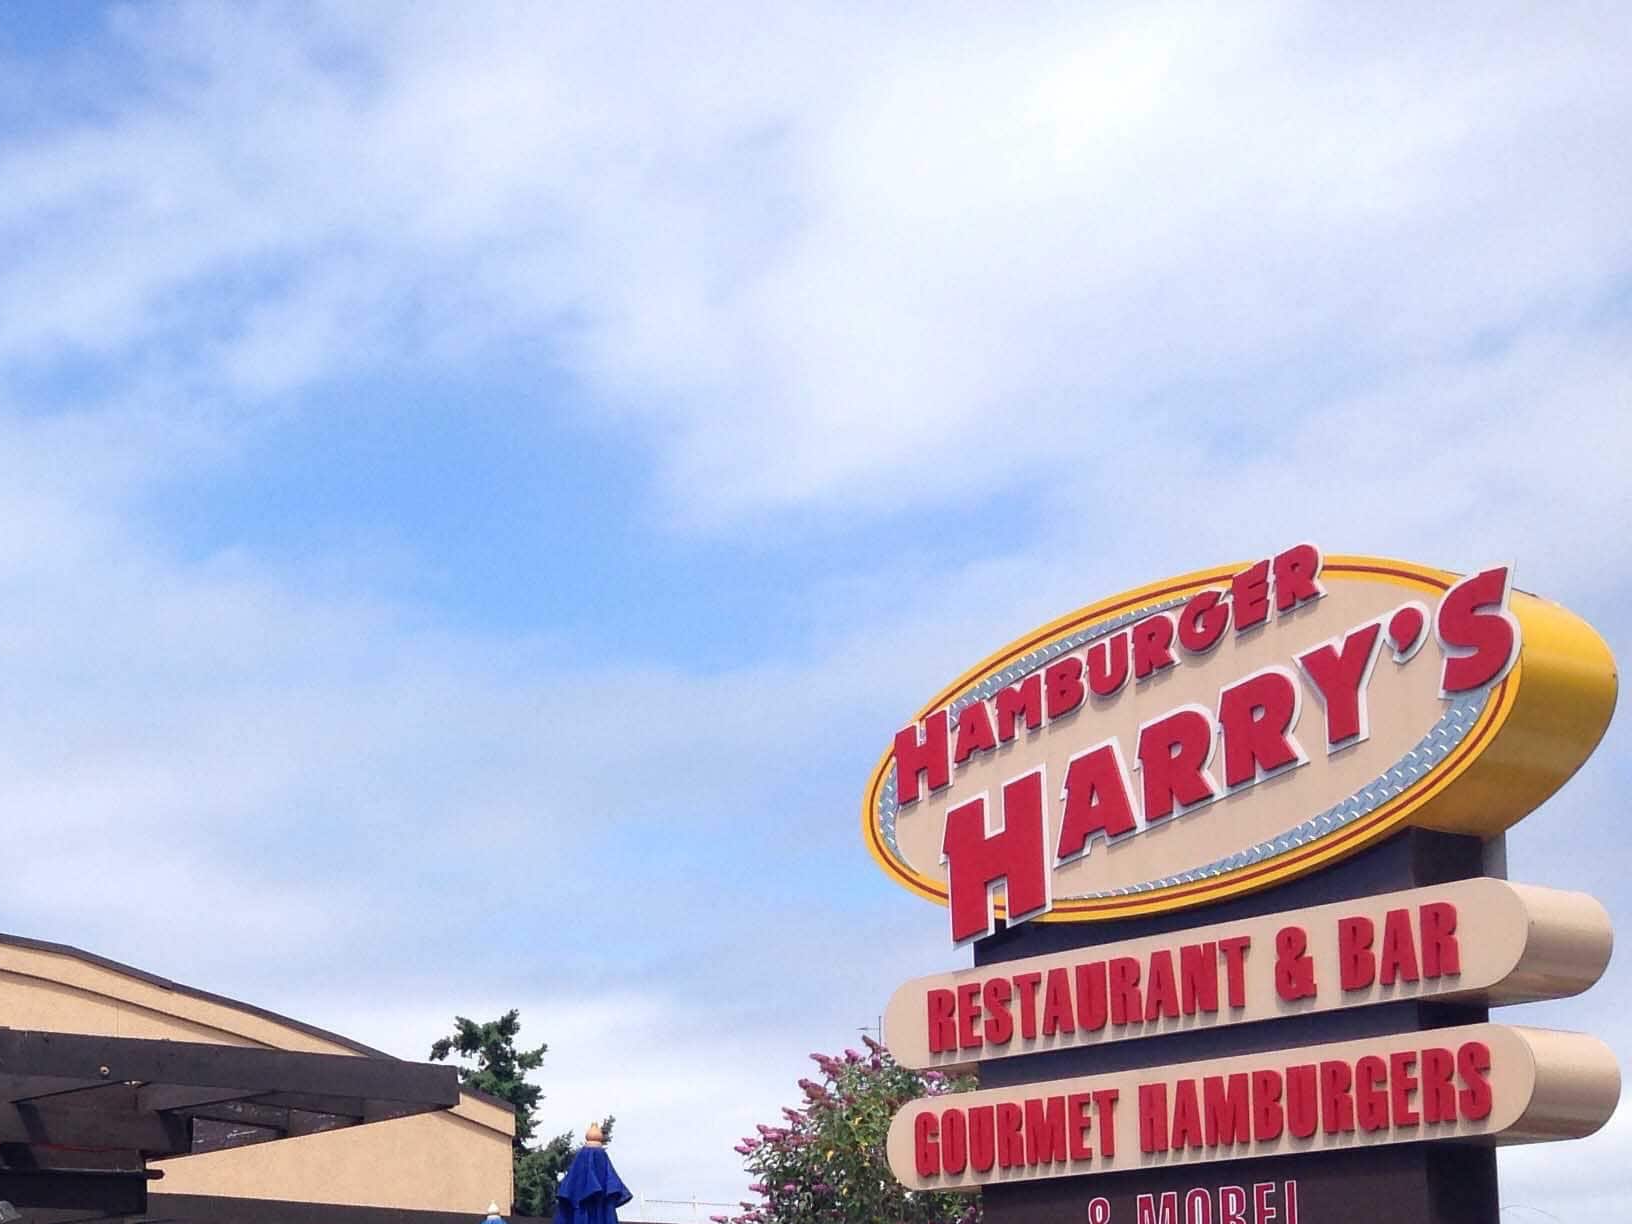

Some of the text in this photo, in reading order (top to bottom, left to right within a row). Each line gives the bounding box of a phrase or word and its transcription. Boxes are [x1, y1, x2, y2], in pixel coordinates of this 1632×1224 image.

[894, 543, 1322, 805] HAMBURGER
[943, 563, 1516, 944] HARRY'S
[926, 901, 1461, 1054] RESTAURANT & BAR
[914, 1041, 1493, 1177] GOURMET HAMBURGERS
